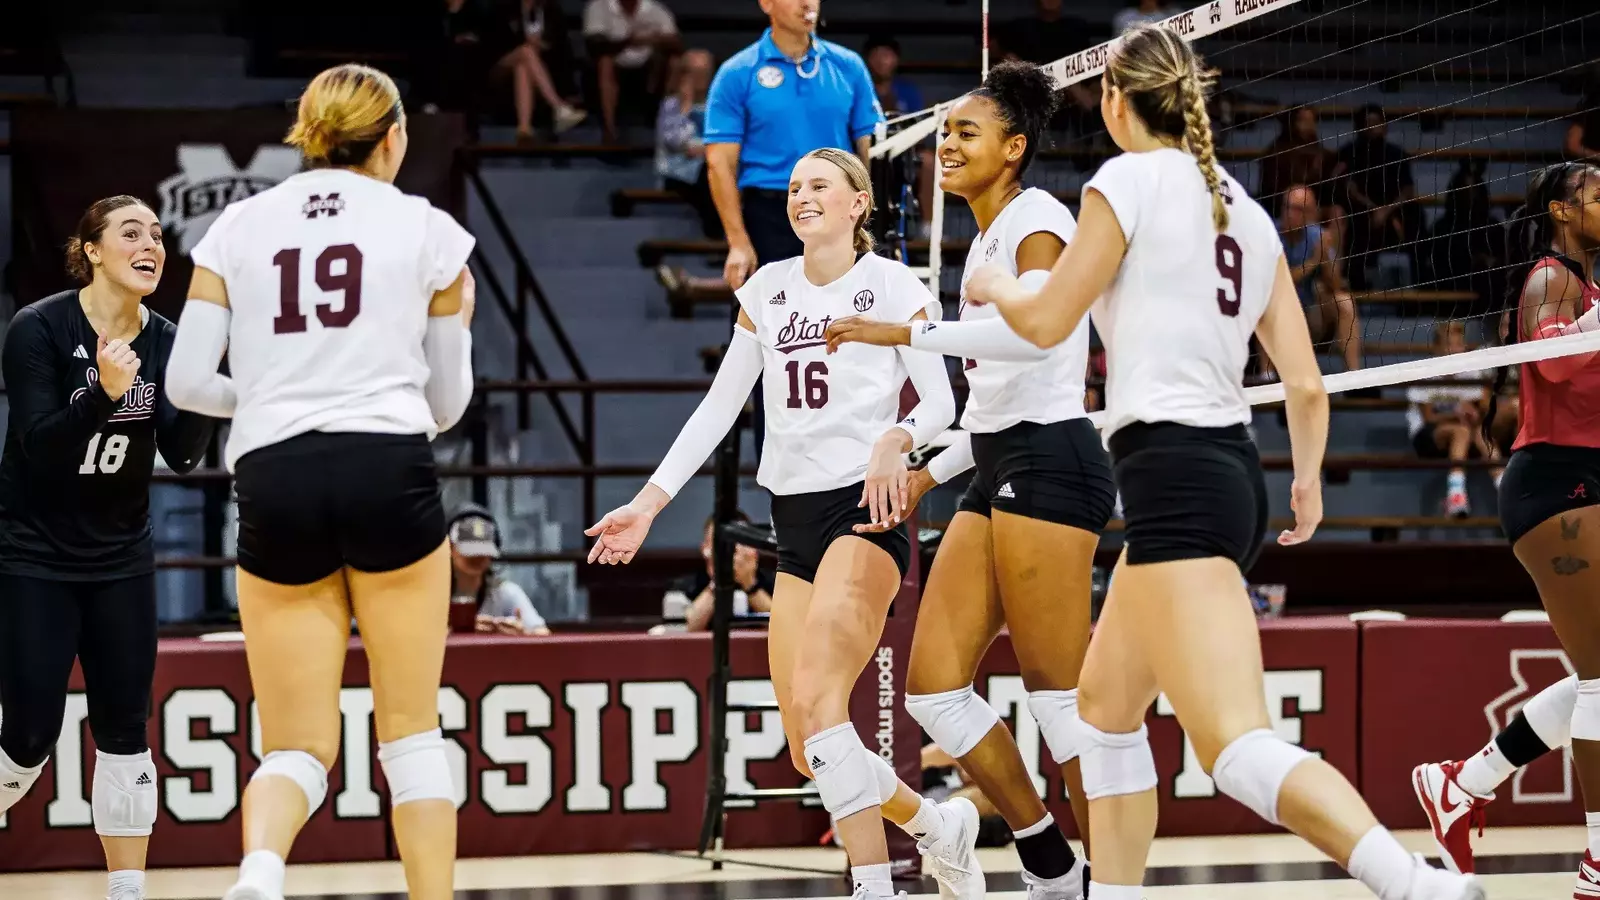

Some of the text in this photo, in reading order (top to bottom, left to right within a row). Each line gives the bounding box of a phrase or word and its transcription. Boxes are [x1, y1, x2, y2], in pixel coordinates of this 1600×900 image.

[1169, 11, 1195, 36] STATE
[1065, 43, 1109, 78] HAIL STATE
[188, 182, 272, 216] STA
[272, 243, 364, 335] 19
[1215, 233, 1243, 318] 9
[774, 311, 832, 347] Stat
[784, 360, 829, 410] 16
[78, 432, 130, 475] 18
[1567, 483, 1588, 499] A
[875, 646, 896, 771] sports impo
[0, 680, 824, 829] ISISIPP
